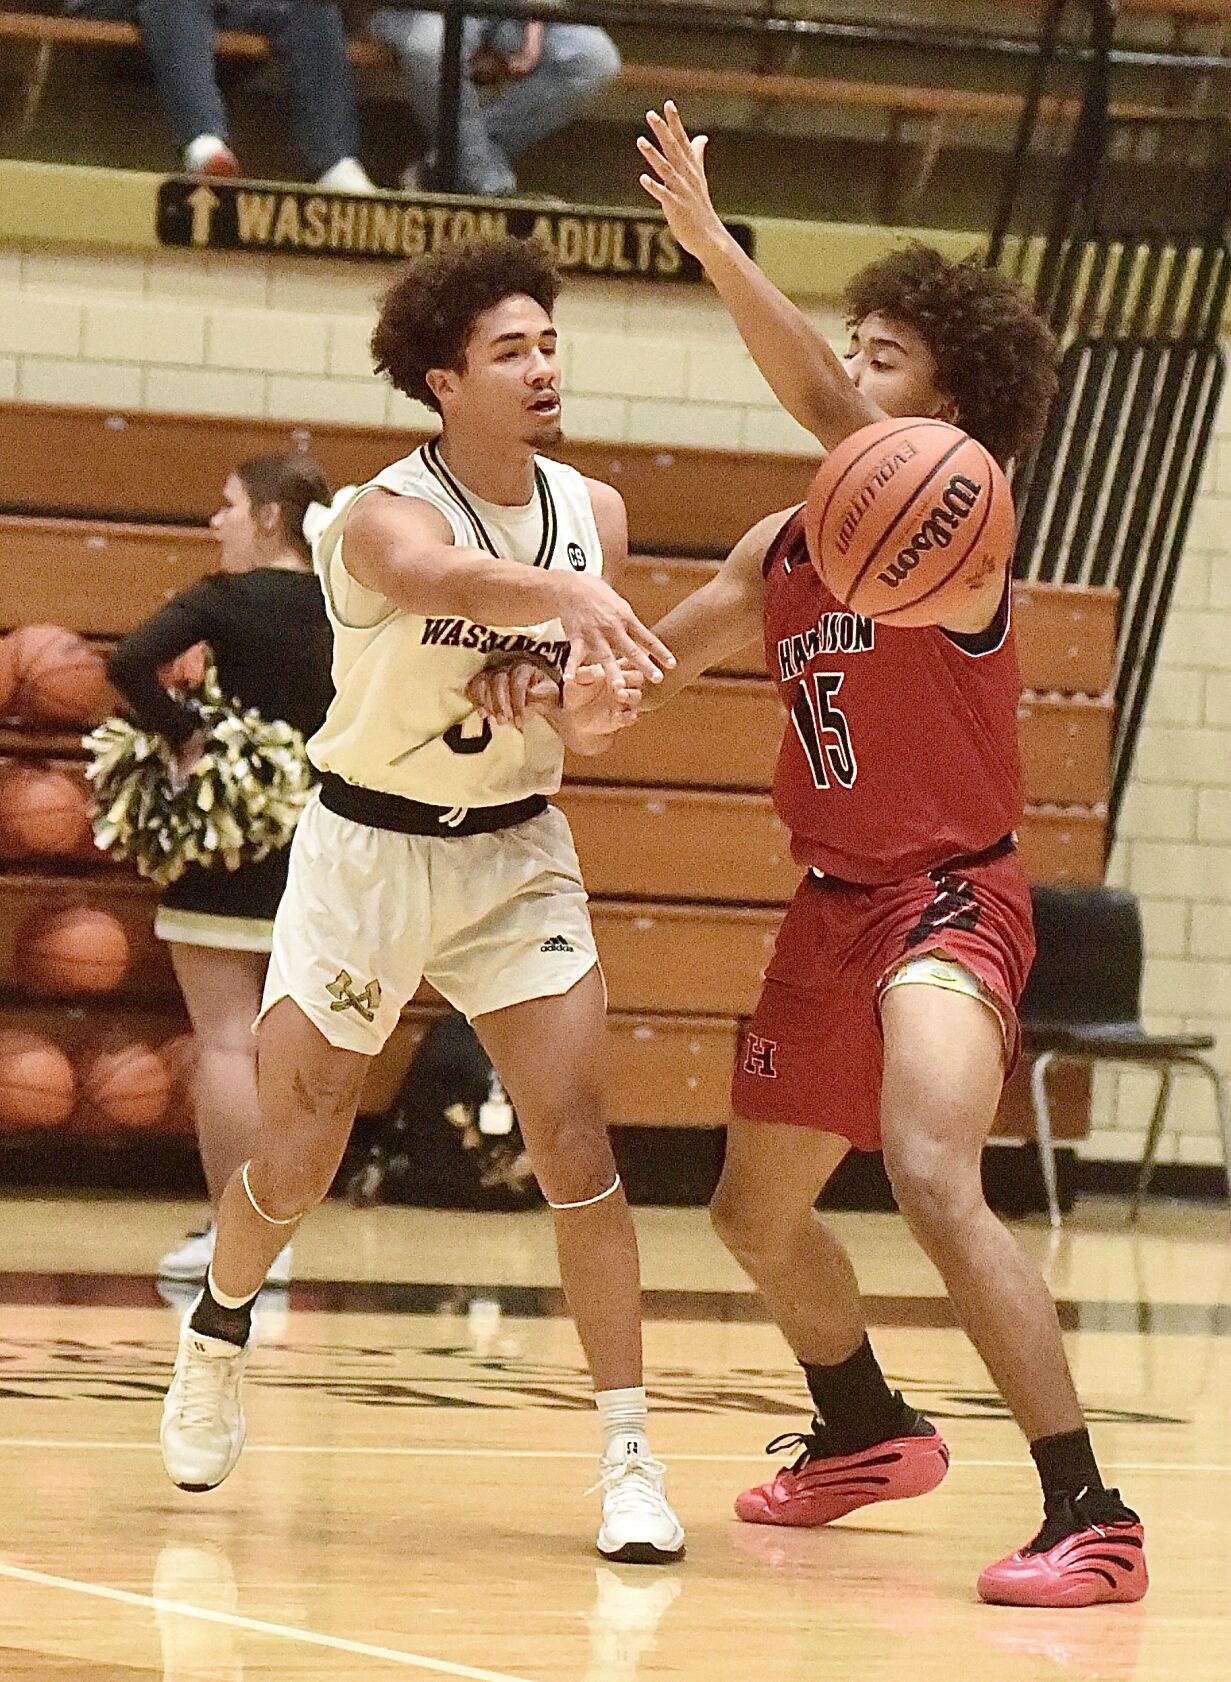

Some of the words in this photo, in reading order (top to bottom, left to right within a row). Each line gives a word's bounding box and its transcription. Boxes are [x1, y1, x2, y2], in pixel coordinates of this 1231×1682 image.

[237, 192, 507, 255] WASHINGTON
[534, 214, 681, 273] ADULTS
[837, 440, 917, 555] EVOLUTION
[876, 473, 982, 588] Wilson
[791, 672, 857, 789] 15
[743, 1032, 777, 1078] H
